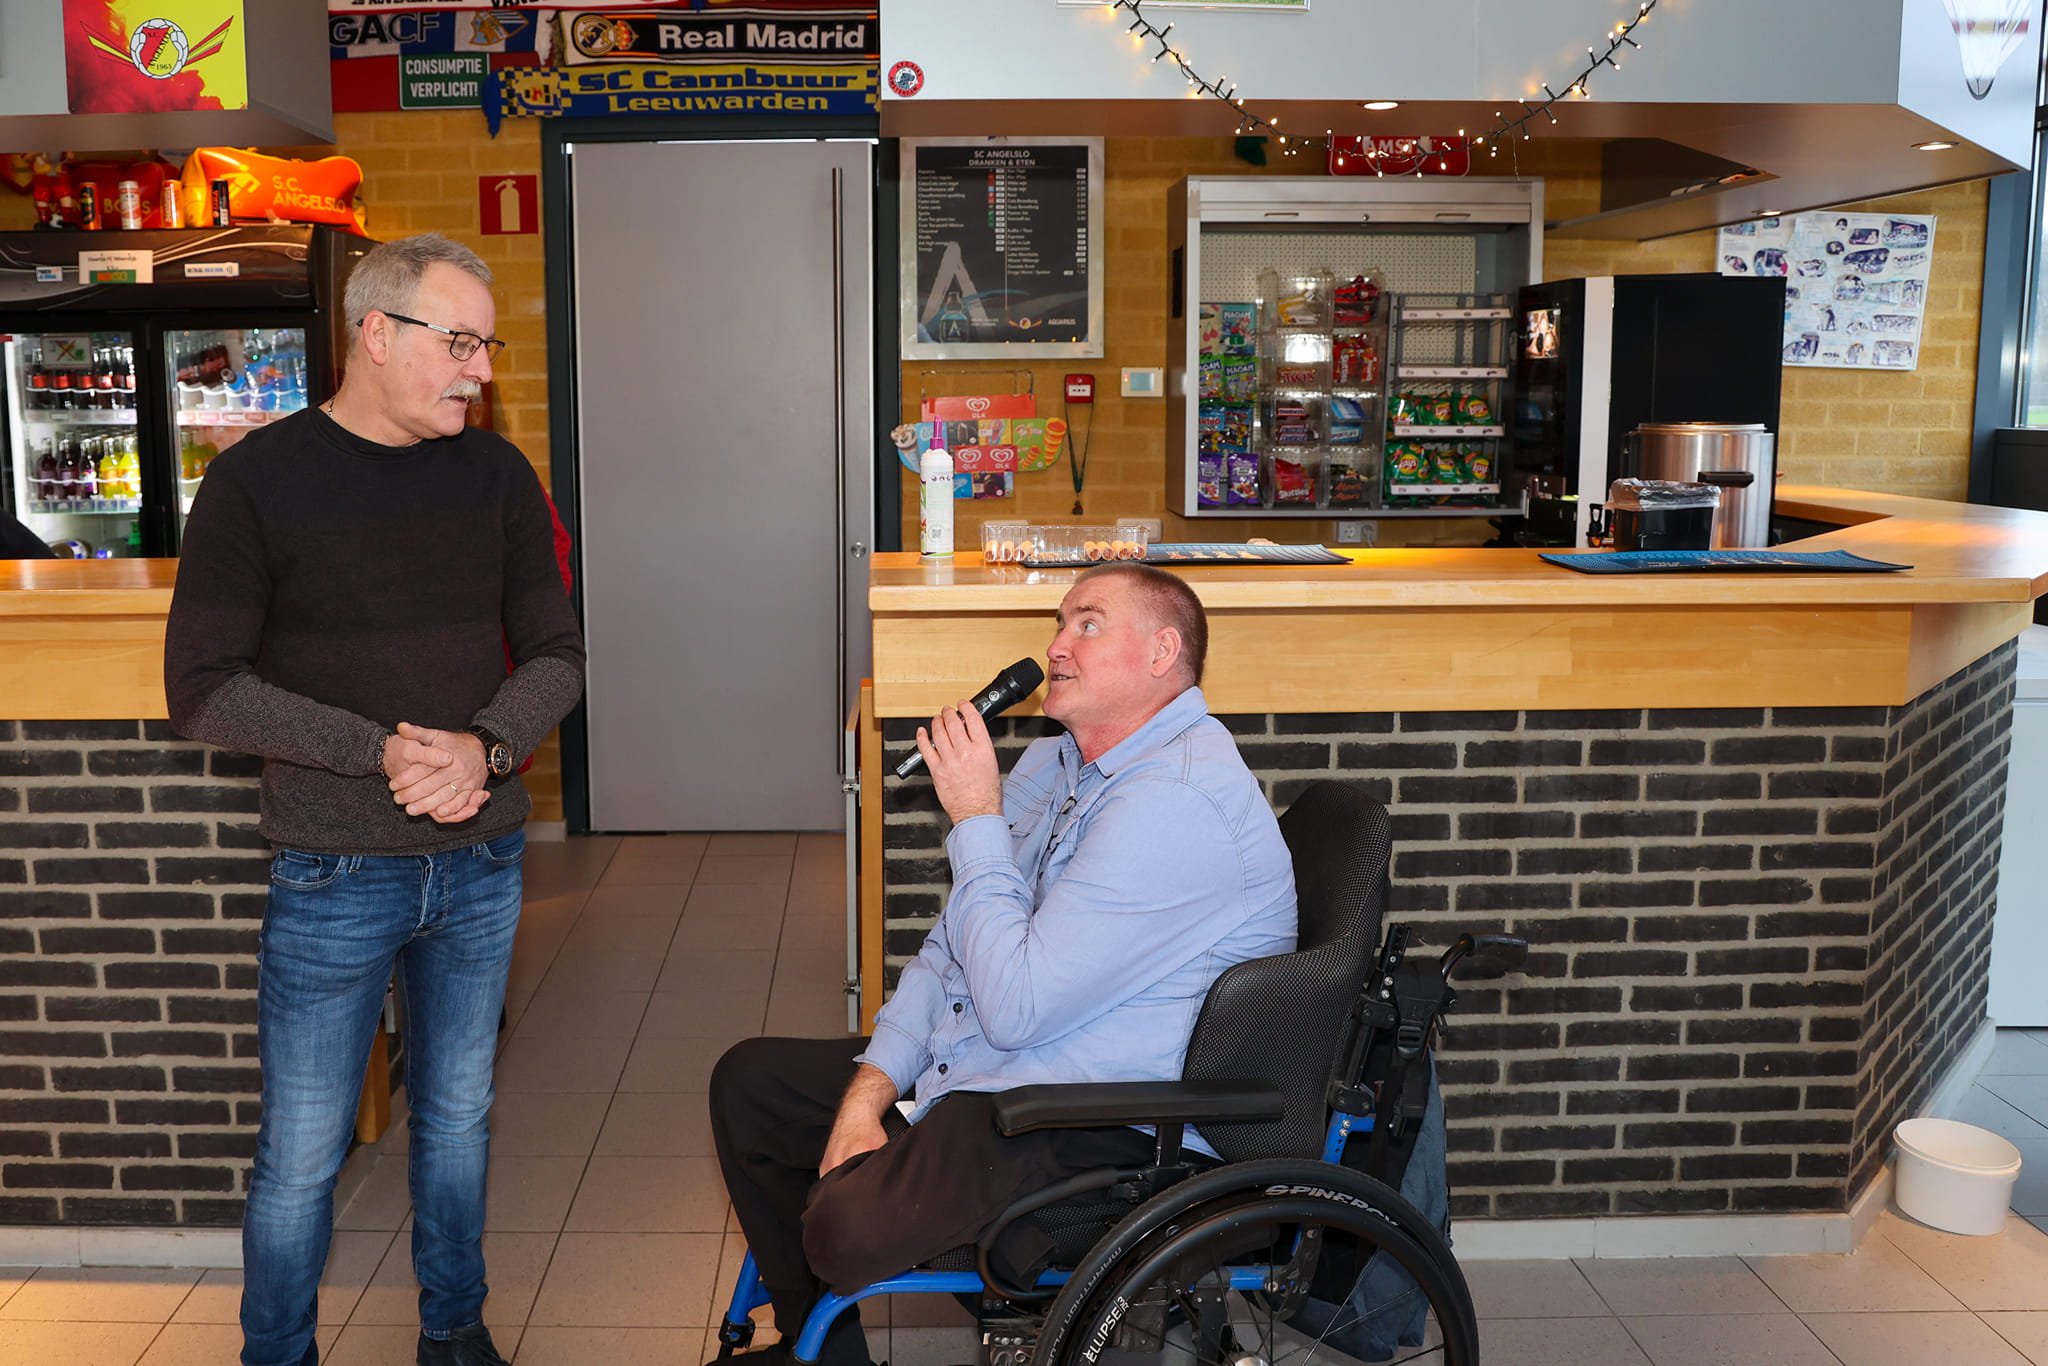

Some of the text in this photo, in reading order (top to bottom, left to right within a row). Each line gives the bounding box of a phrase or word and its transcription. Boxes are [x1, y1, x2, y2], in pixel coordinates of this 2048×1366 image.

[658, 24, 865, 49] Real Madrid
[405, 58, 483, 75] CONSUMPTIE
[410, 81, 478, 97] VERPLICHT!
[578, 68, 858, 91] SC Cambuur
[608, 93, 829, 112] Leeuwarden
[986, 150, 1031, 159] ANGELSLO
[272, 191, 346, 213] ANGELSLO
[1085, 1306, 1121, 1363] ELLIPSE
